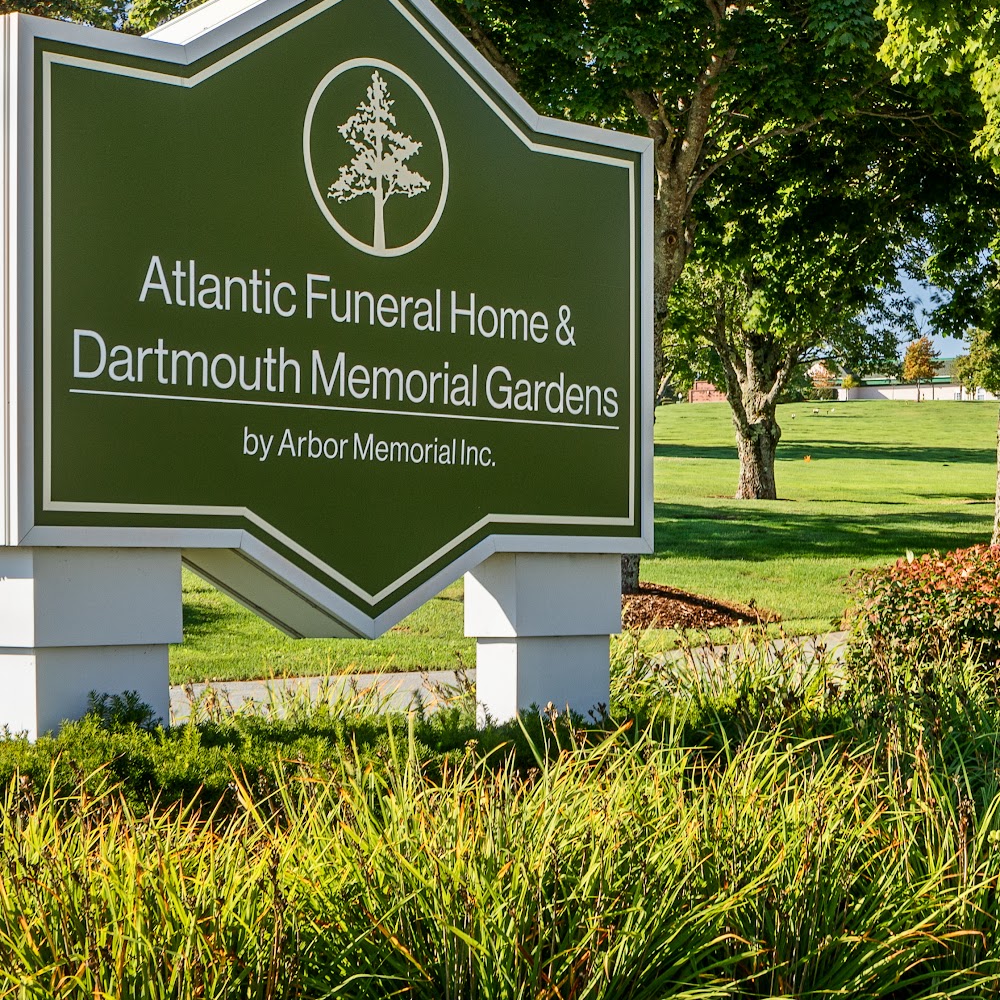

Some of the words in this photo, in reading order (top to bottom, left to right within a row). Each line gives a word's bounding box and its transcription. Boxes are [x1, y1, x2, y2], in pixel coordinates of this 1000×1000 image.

[138, 255, 297, 319] Atlantic
[306, 273, 441, 332] Funeral
[450, 290, 549, 344] Home
[555, 304, 577, 347] &
[73, 328, 301, 394] Dartmouth
[311, 349, 478, 407] Memorial
[485, 365, 619, 418] Gardens
[243, 425, 275, 462] by
[277, 428, 349, 460] Arbor
[353, 432, 457, 465] Memorial
[460, 438, 497, 468] Inc.
